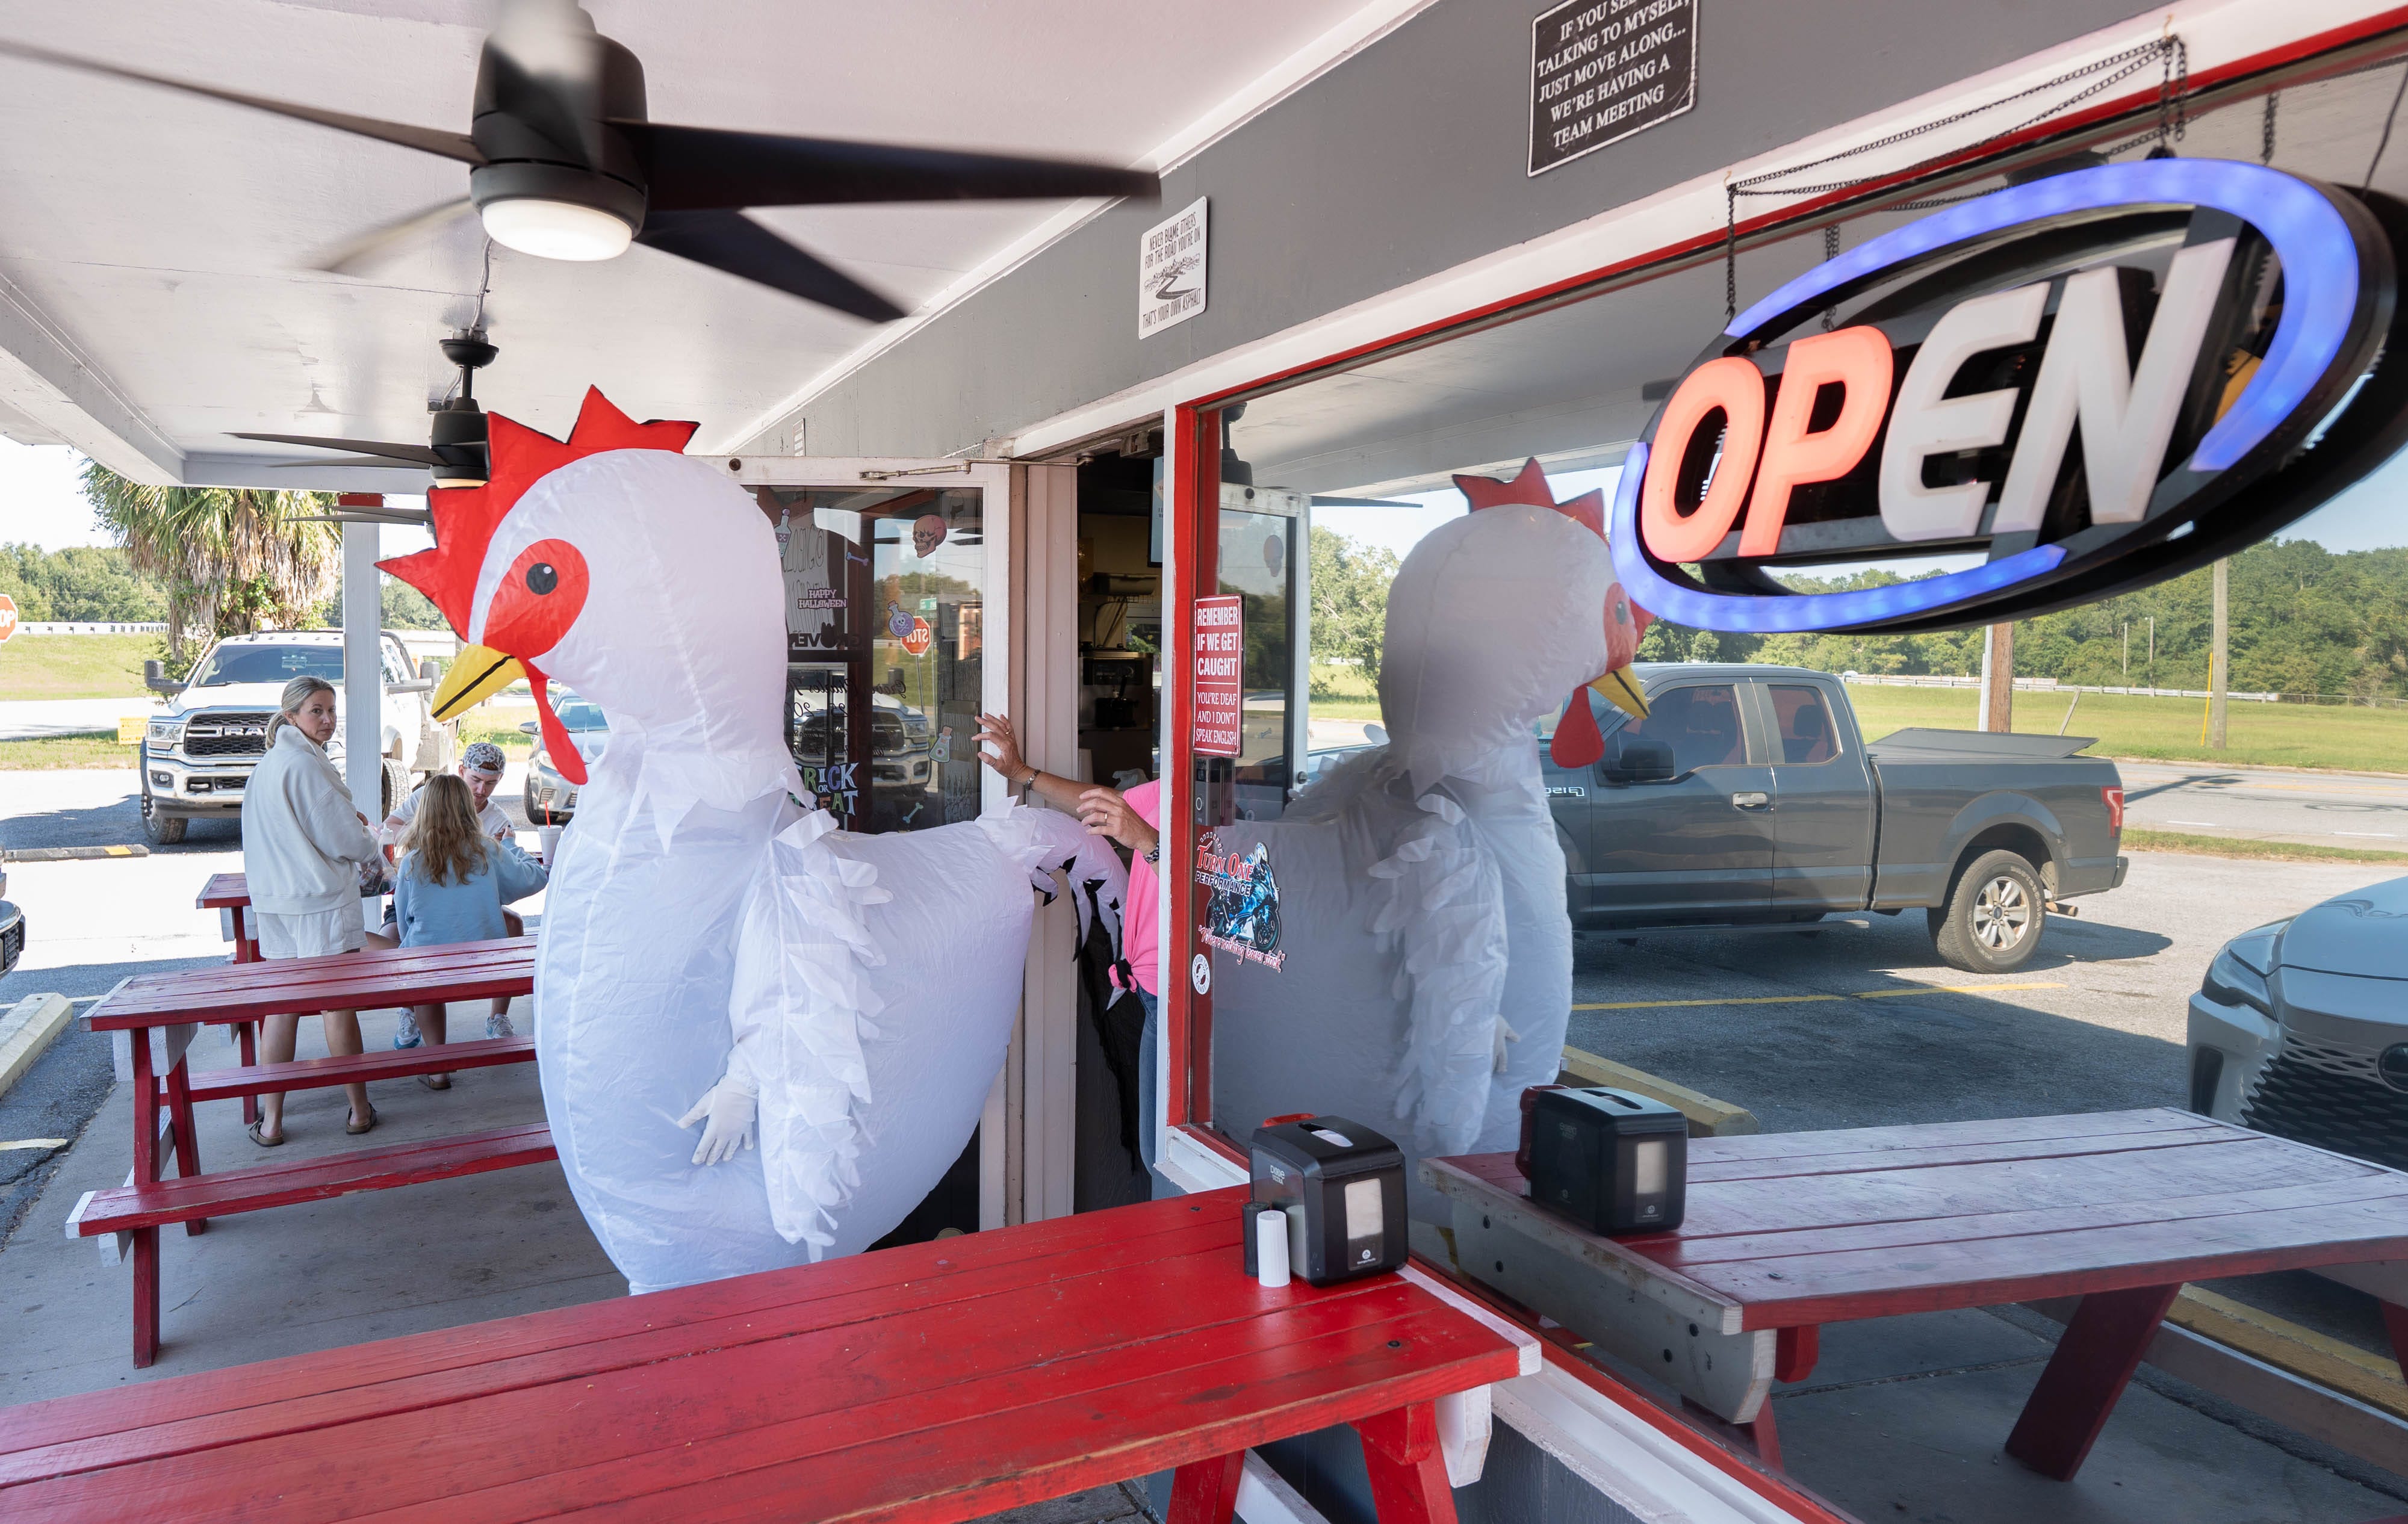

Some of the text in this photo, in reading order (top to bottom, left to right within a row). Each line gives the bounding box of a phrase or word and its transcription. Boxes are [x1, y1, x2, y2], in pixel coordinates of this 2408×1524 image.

[1560, 22, 1573, 41] IF
[1577, 2, 1607, 33] YOU
[1537, 34, 1598, 78] TALKING
[1603, 22, 1621, 46] TO
[1539, 22, 1686, 103] JUST MOVE ALONG...
[1550, 54, 1671, 123] WE'RE HAVING A
[1553, 84, 1665, 148] TEAM MEETING
[1150, 212, 1196, 252] NEVER BLAME OTHERS
[1145, 253, 1153, 270] FOR
[1165, 241, 1177, 260] ROAD
[1178, 231, 1193, 252] YOU'RE
[1194, 226, 1200, 243] ON
[1143, 288, 1201, 329] THAT'S YOUR OWN ASPHALT
[1642, 237, 2237, 563] OPEN
[798, 599, 846, 609] HALLOWEEN
[808, 589, 837, 598] HAPPY
[0, 609, 16, 628] OP
[1197, 606, 1238, 627] REMEMBER
[1197, 633, 1238, 651] IF WE GET
[1197, 658, 1237, 676] CAUGHT
[1197, 692, 1237, 705] YOU'RE DEAF
[1197, 711, 1235, 725] AND I DON'T
[1196, 728, 1237, 746] SPEAK ENGLISH
[818, 785, 831, 793] OR
[1195, 870, 1252, 897] PERFORMANCE
[1221, 935, 1245, 965] nothing
[1245, 940, 1264, 964] leaves
